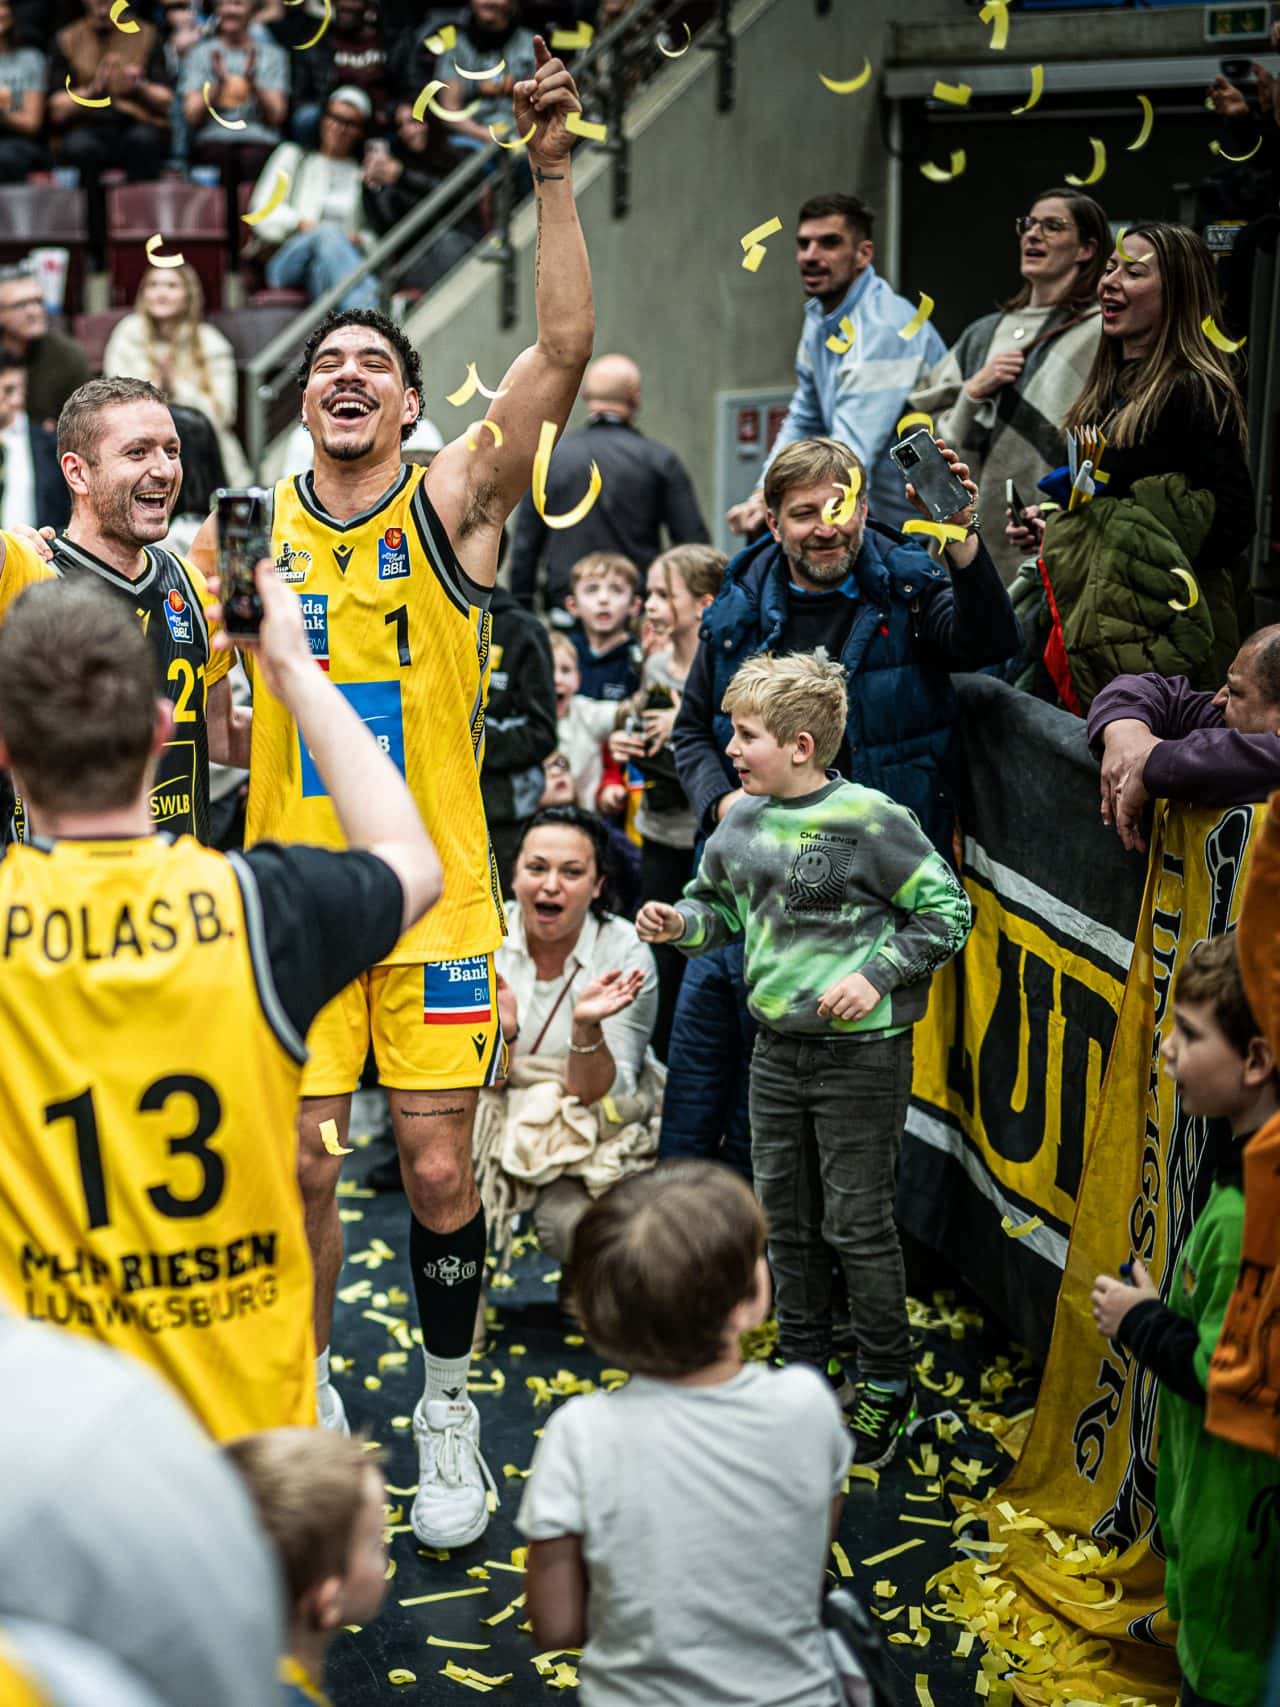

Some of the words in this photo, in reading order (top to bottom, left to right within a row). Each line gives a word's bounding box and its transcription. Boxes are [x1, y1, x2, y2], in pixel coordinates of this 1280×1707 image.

[382, 561, 407, 577] BBL
[173, 626, 190, 639] BBL
[385, 604, 412, 667] 1
[149, 793, 191, 816] SWLB
[800, 831, 858, 847] CHALLENGE
[3, 899, 178, 962] POLAS
[188, 891, 236, 943] B.
[448, 965, 488, 982] Bank
[43, 1074, 227, 1231] 13
[120, 1231, 278, 1293] RIESEN
